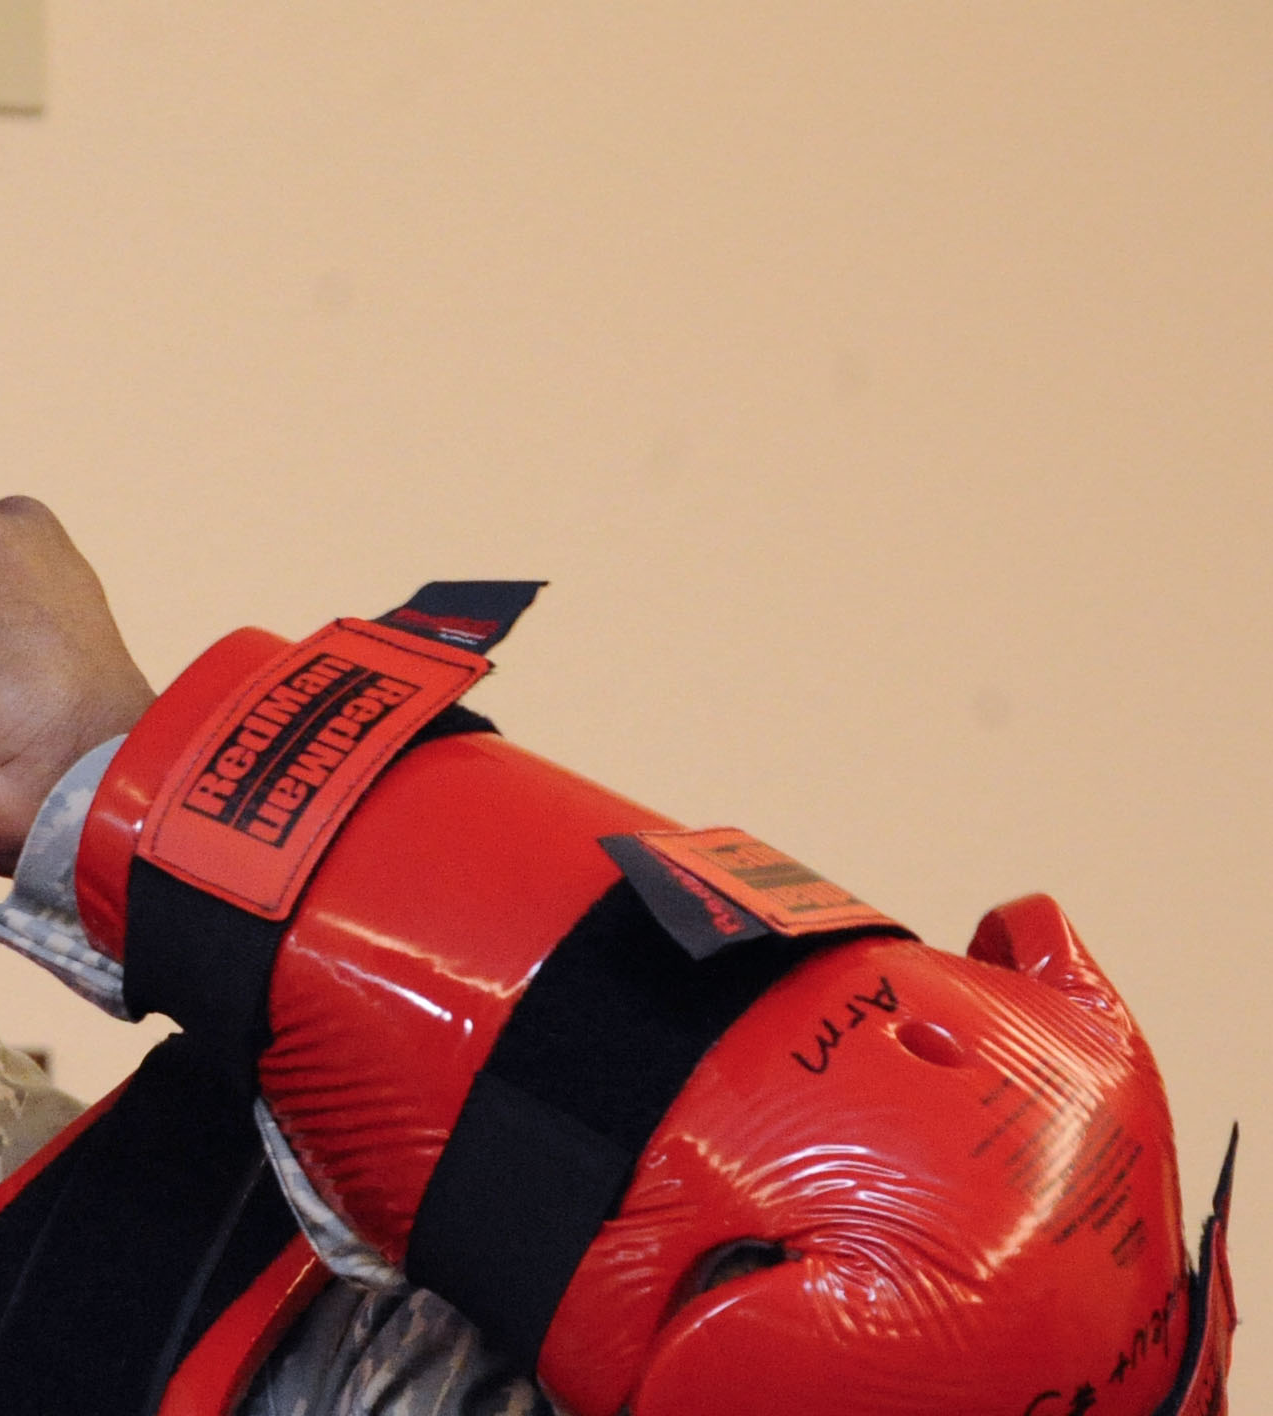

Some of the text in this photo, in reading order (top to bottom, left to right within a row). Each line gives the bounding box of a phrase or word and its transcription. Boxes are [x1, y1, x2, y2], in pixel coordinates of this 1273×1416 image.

[189, 655, 355, 820] RedMan
[246, 675, 418, 846] RedMan
[791, 975, 899, 1075] Arm
